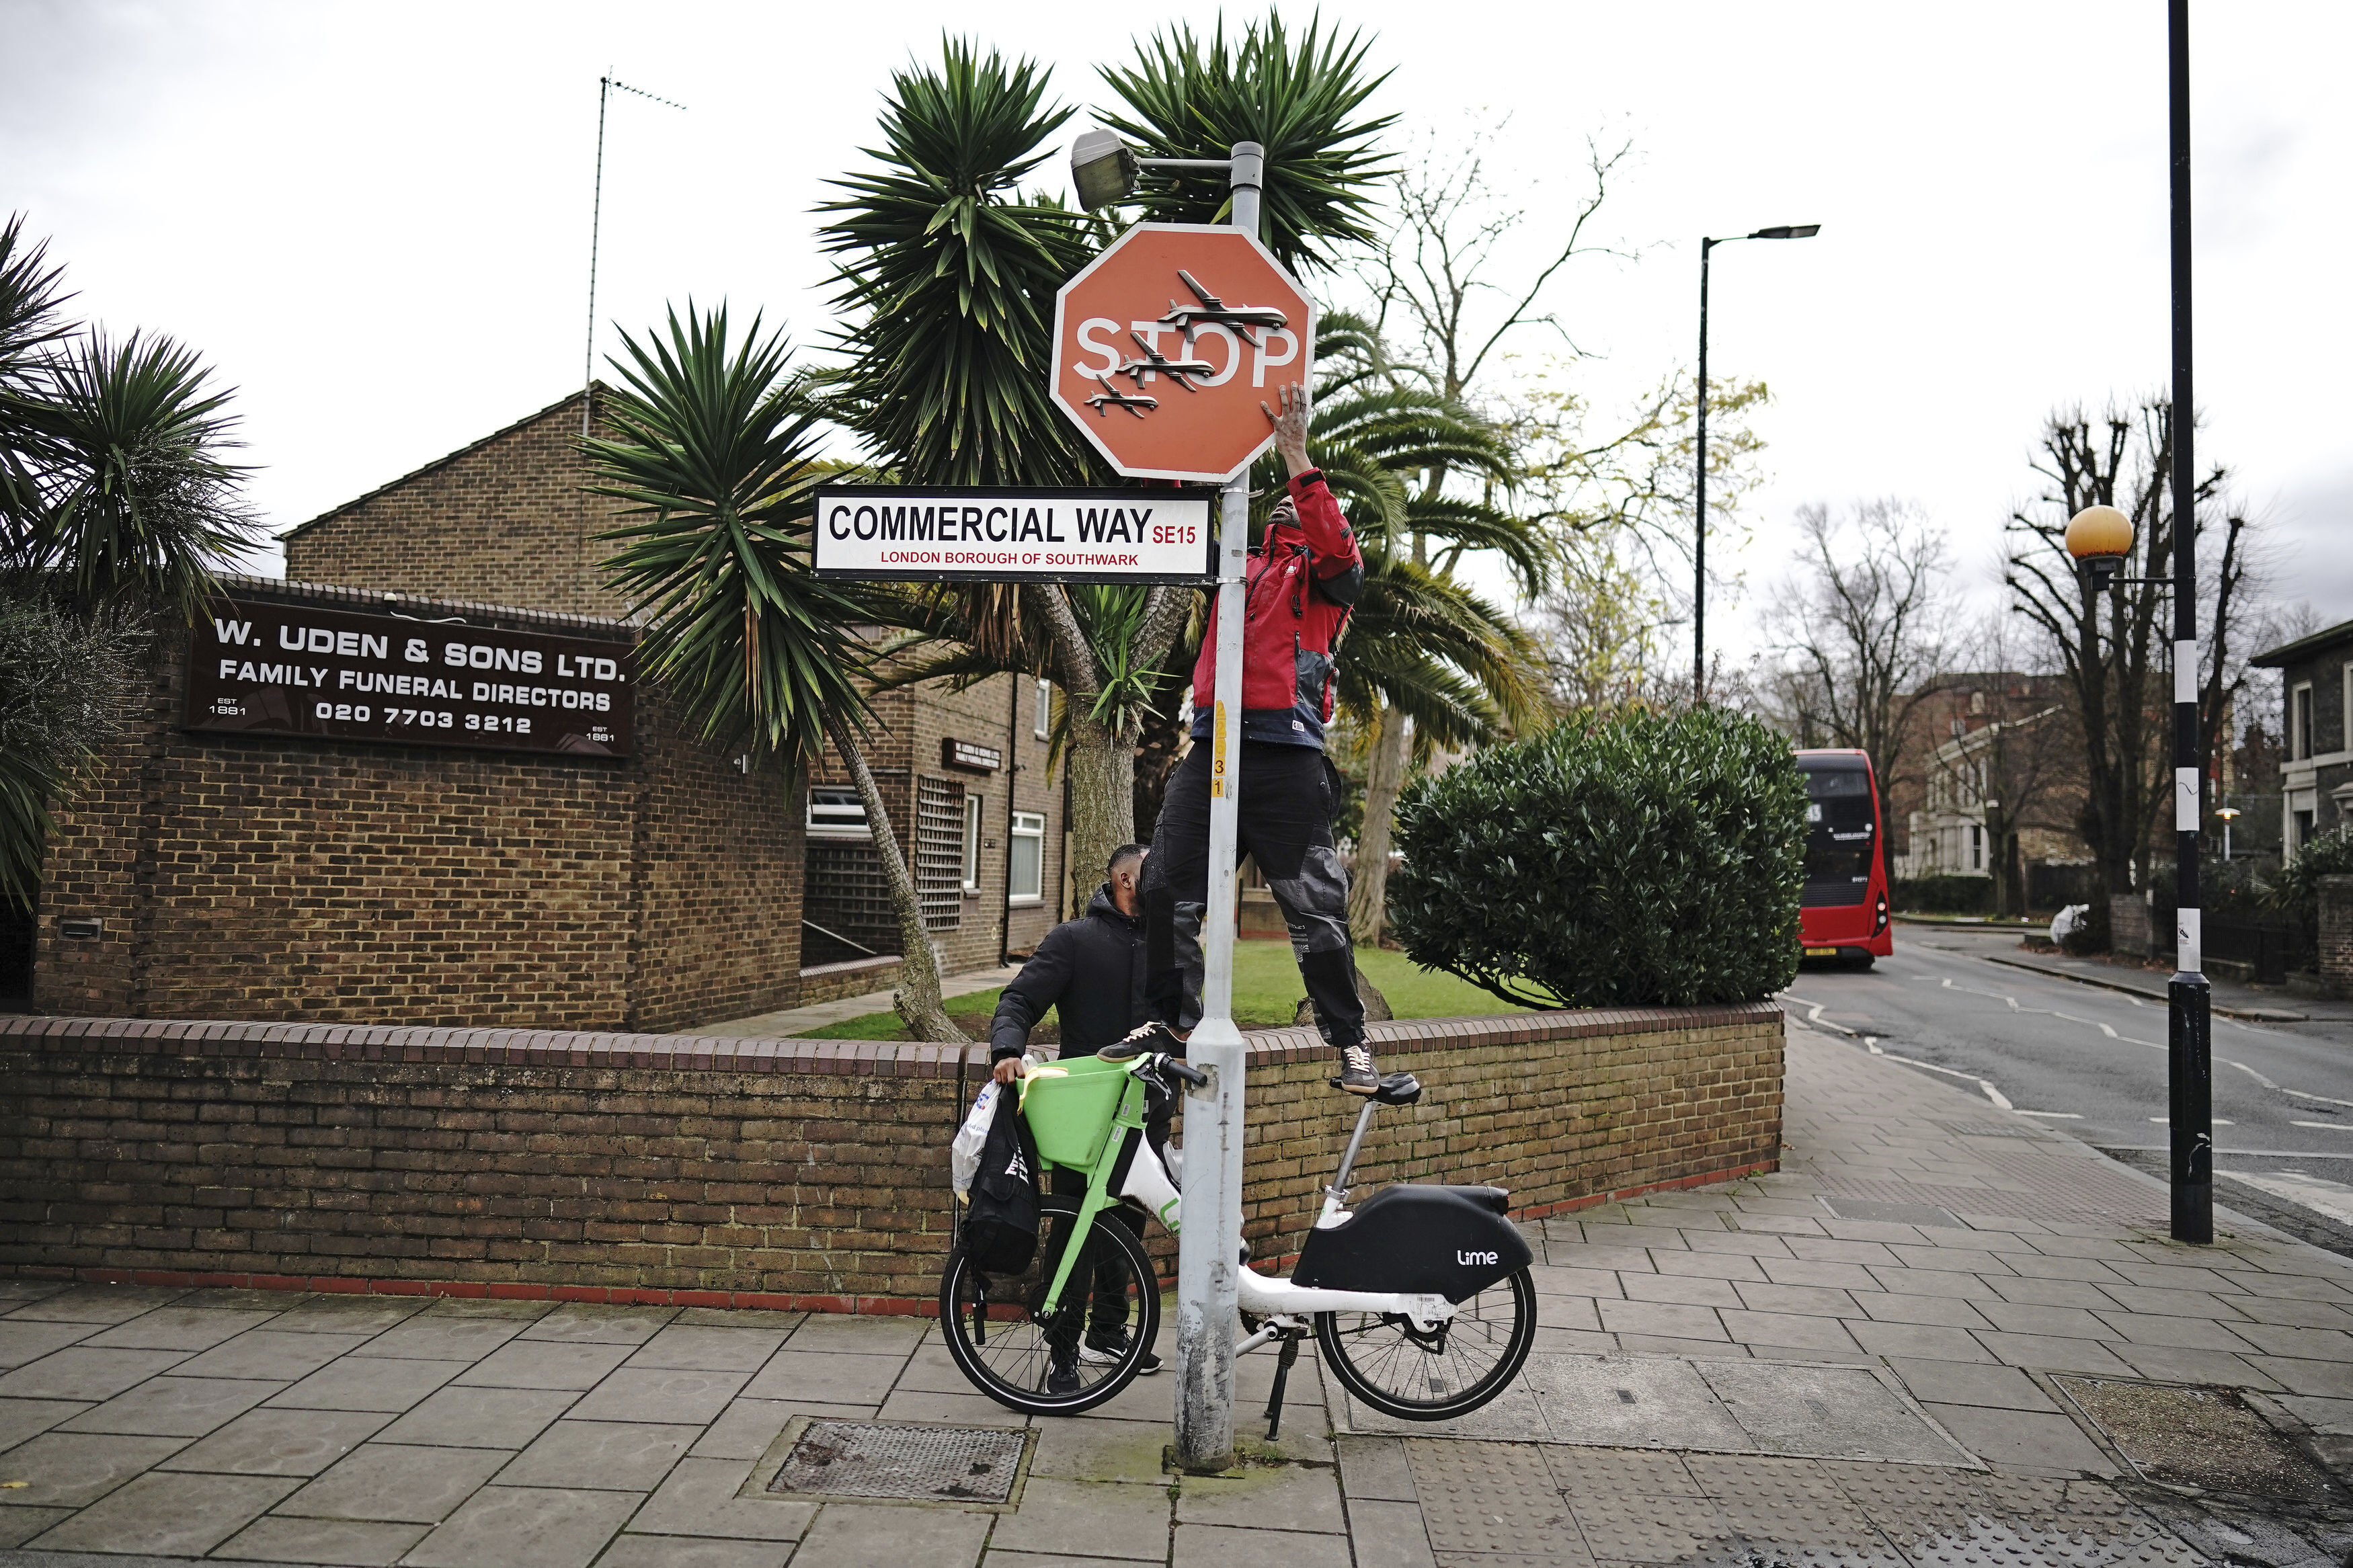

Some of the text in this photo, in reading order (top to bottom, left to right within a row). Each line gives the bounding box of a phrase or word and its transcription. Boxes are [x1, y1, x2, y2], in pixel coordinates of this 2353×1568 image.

[1072, 318, 1299, 388] STOP
[829, 505, 1195, 544] COMMERCIAL WAY SE15
[881, 551, 1138, 565] LONDON BOROUGH OF SOUTHWARK
[214, 618, 625, 682] W. UDEN & SONS LTD.
[219, 659, 610, 712] FAMILY FUNERAL DIRECTORS
[209, 705, 246, 716] 1881
[315, 702, 531, 734] 020 7703 3212
[586, 733, 614, 742] 1881
